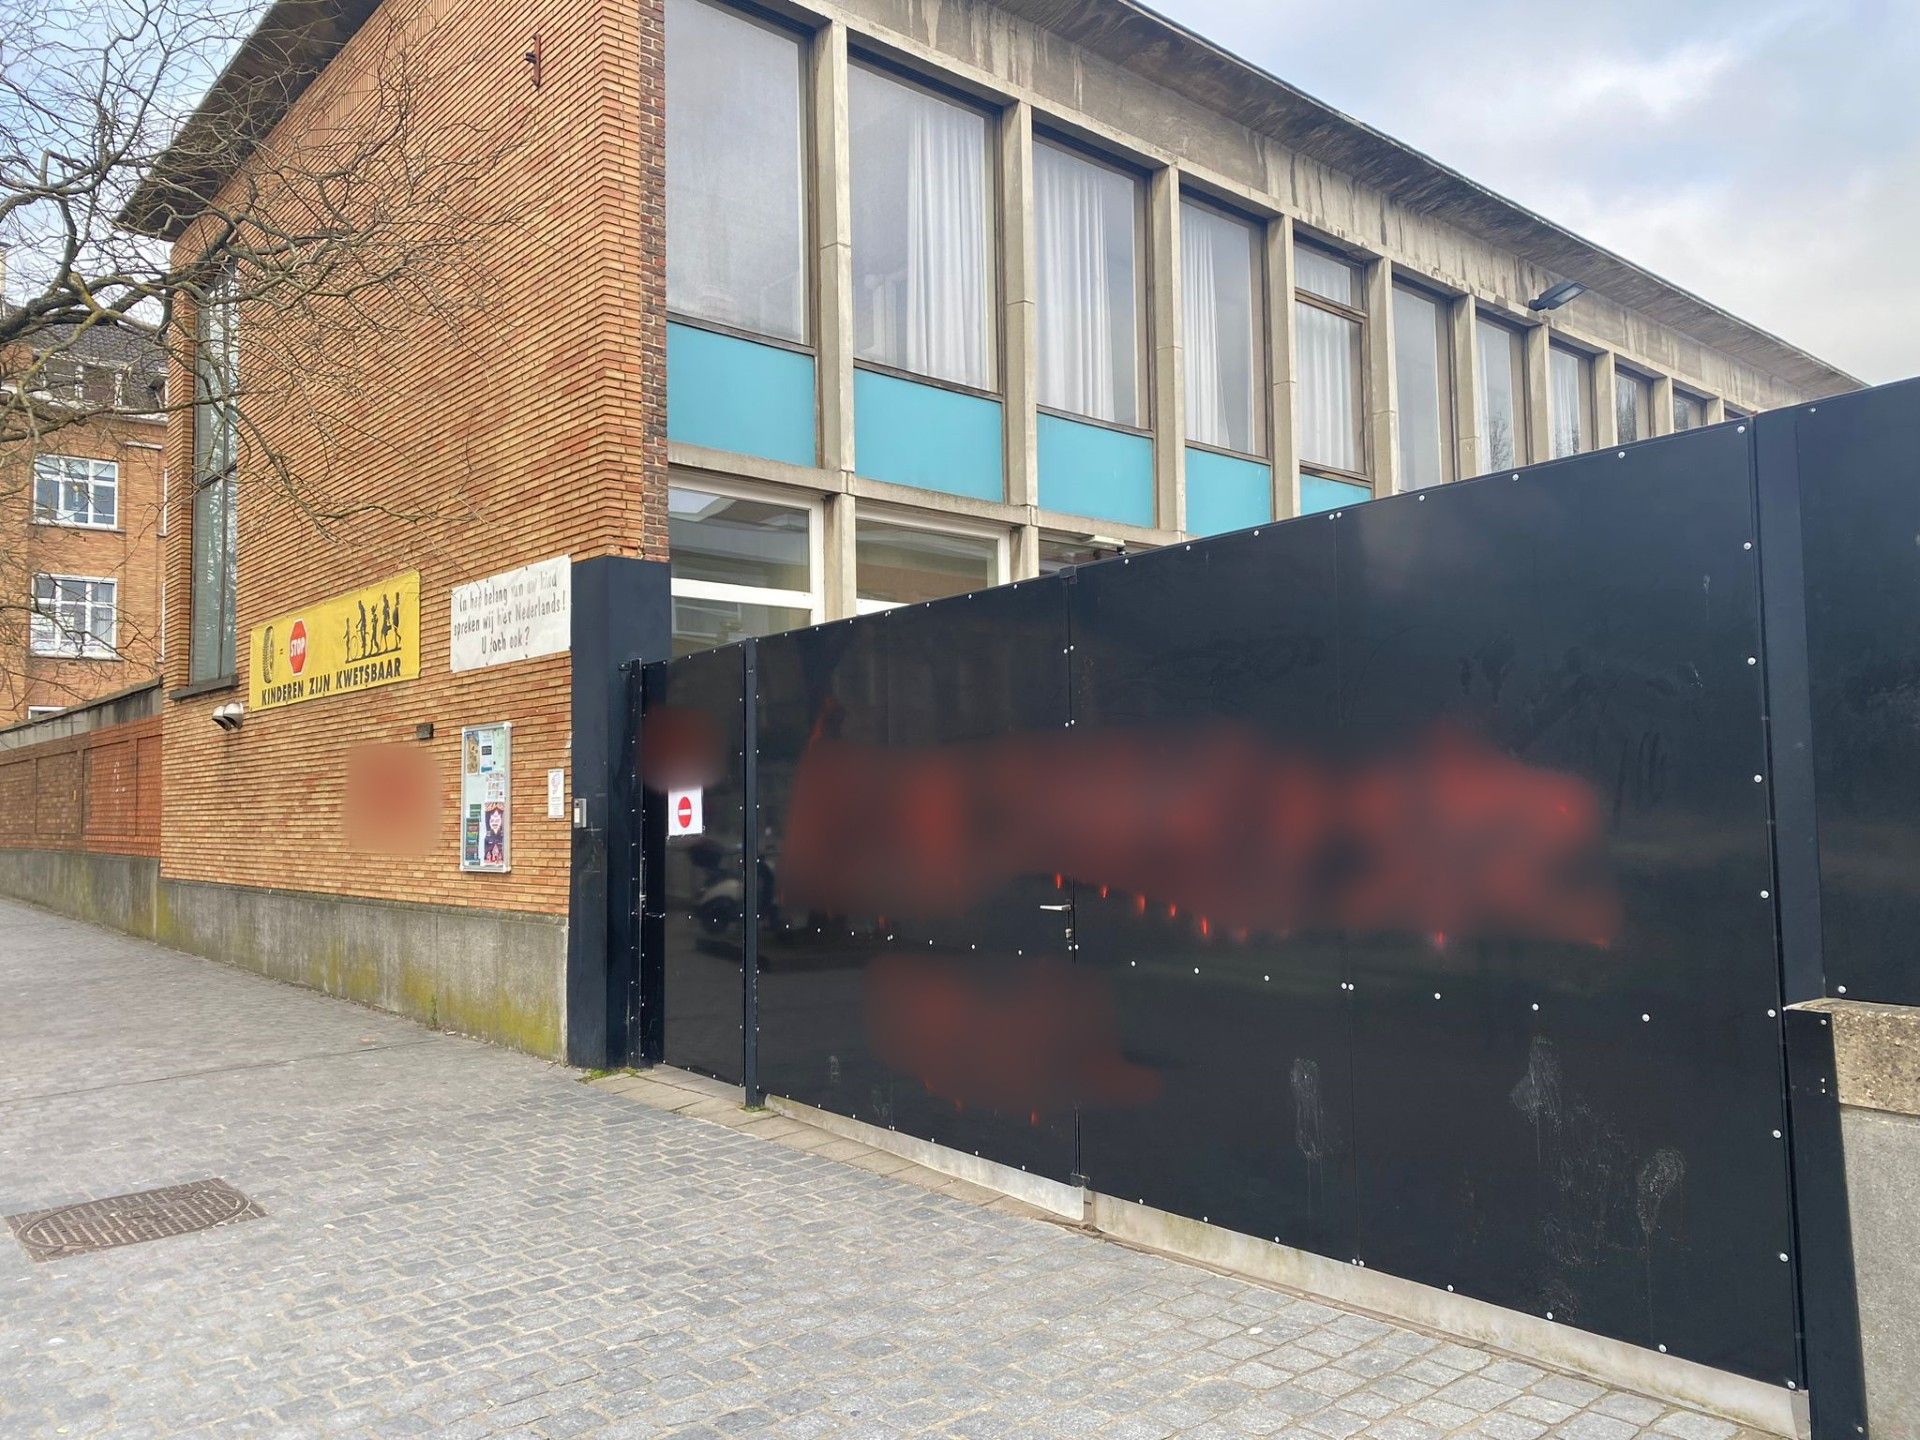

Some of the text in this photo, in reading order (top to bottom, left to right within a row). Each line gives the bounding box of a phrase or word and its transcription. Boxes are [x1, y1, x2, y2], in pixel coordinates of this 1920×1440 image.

[484, 585, 508, 606] belang
[454, 616, 480, 640] spreken
[483, 611, 494, 634] wij
[290, 636, 306, 658] STOP
[481, 635, 487, 654] U
[261, 657, 401, 706] KINDEREN ZIJN KWETSBAAR
